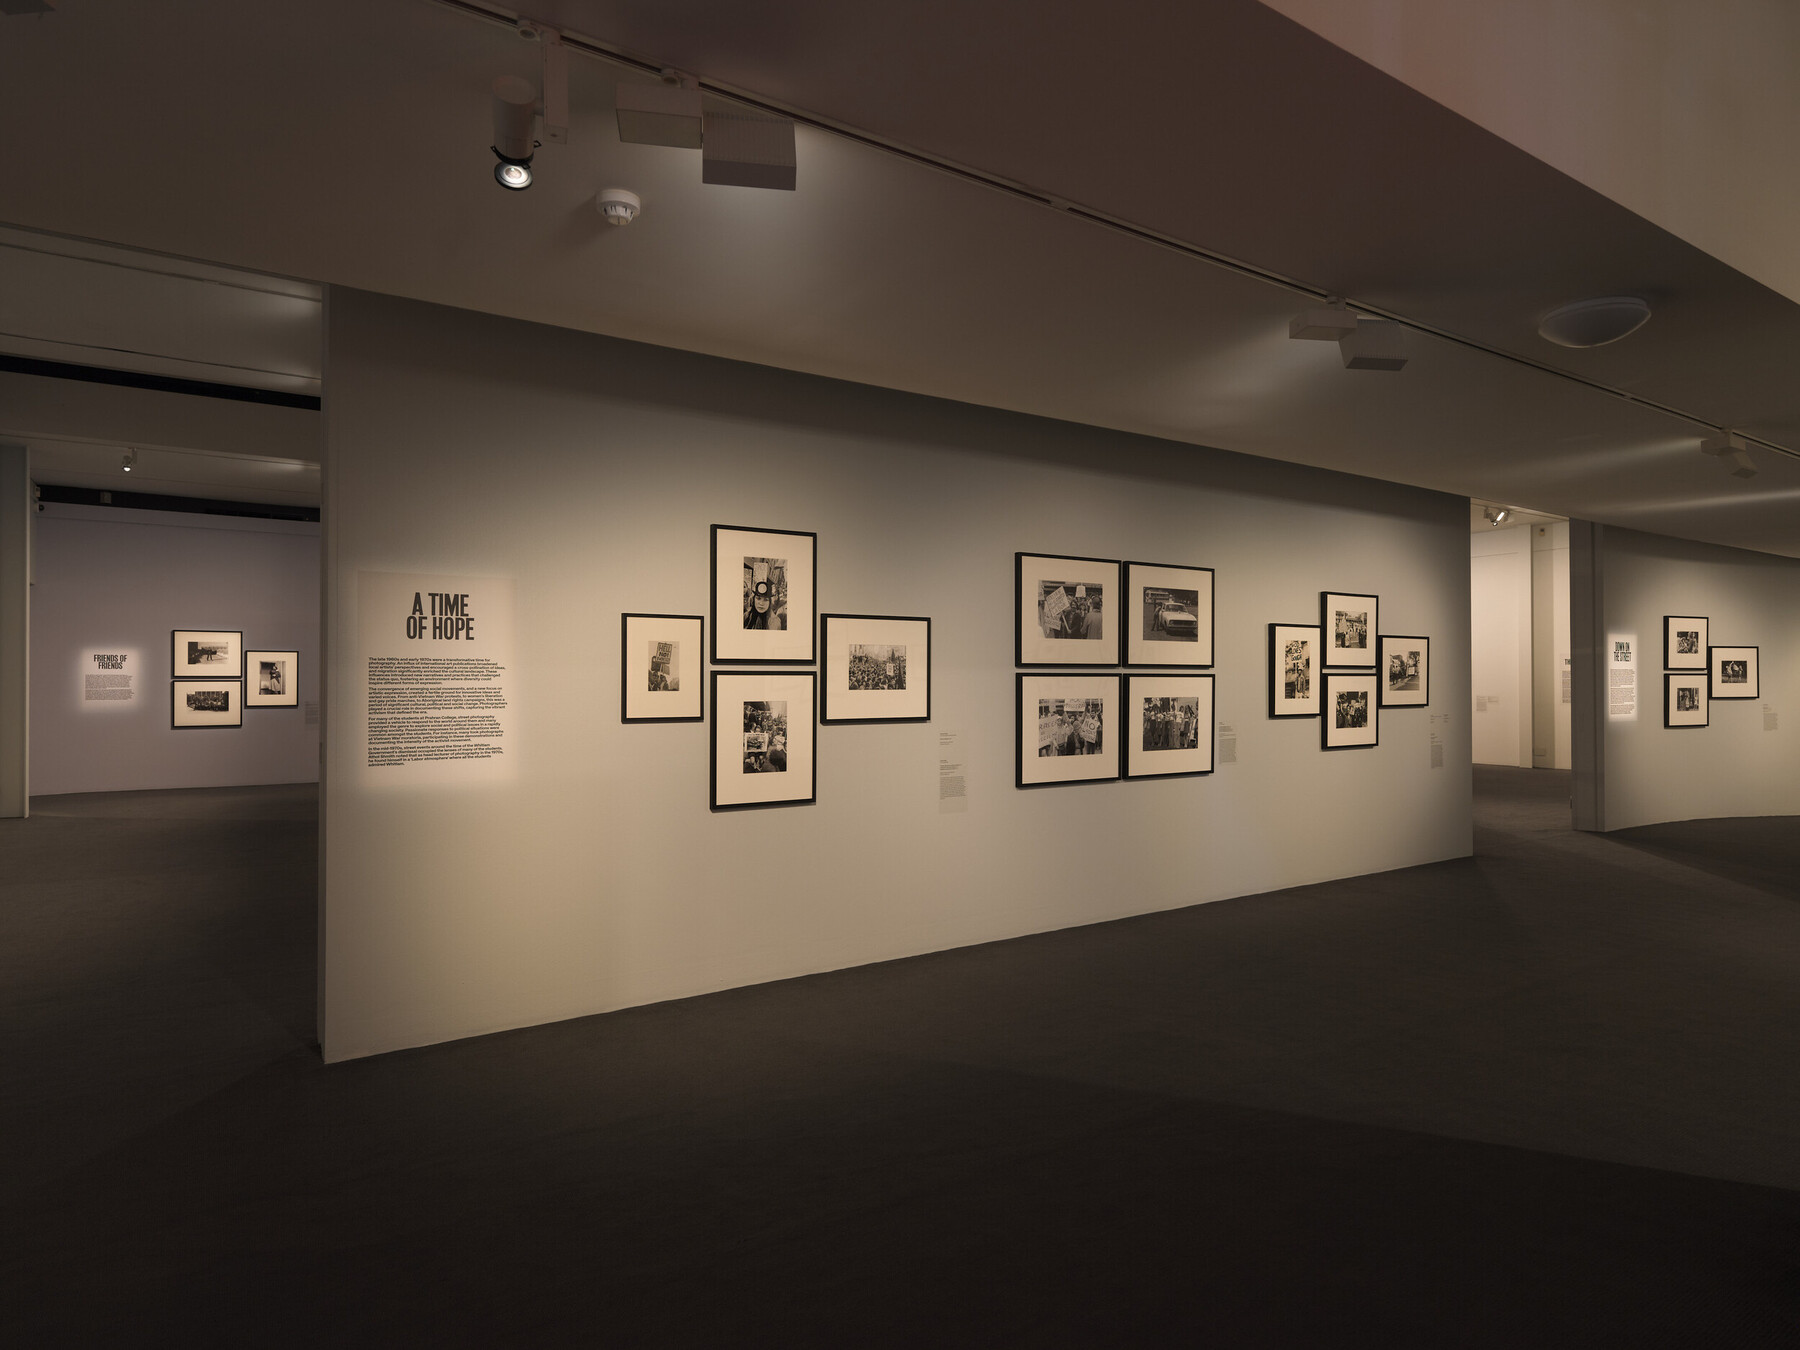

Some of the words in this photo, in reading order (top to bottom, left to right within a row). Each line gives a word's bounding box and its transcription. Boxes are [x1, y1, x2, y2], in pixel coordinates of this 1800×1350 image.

[412, 592, 424, 615] A
[428, 592, 469, 616] TIME
[406, 616, 428, 639] OF
[432, 616, 474, 640] HOPE
